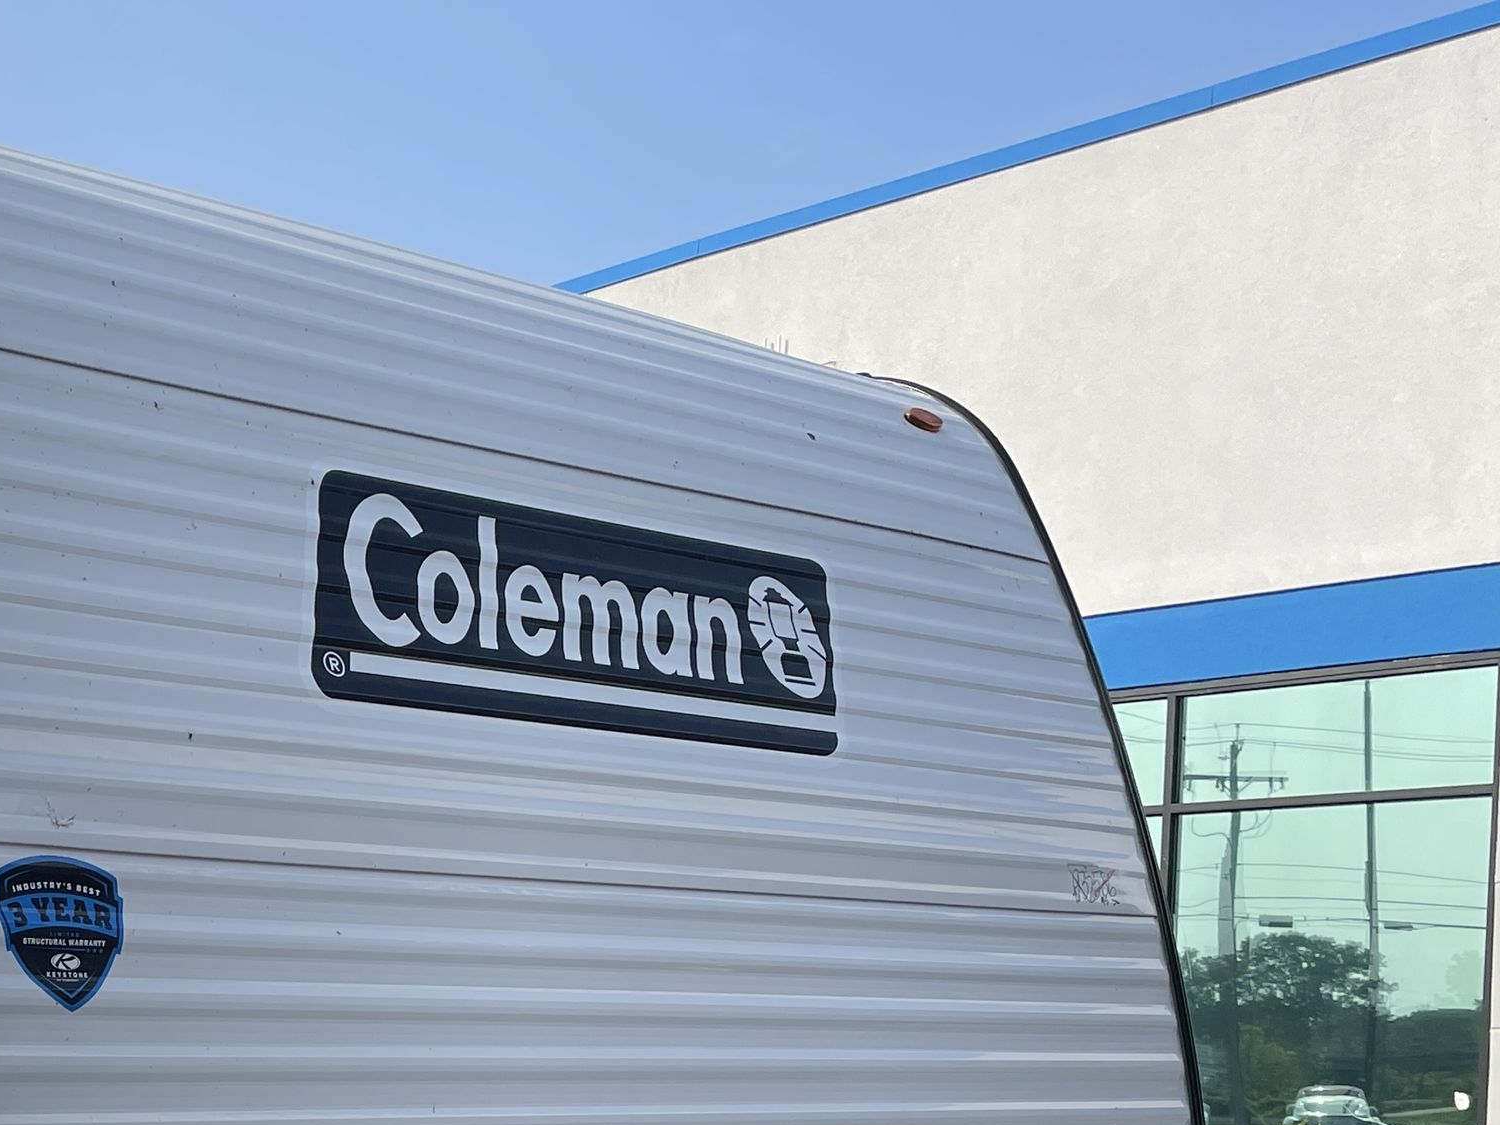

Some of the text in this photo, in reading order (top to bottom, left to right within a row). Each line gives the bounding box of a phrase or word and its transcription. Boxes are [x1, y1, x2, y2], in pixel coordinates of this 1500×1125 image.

[343, 492, 744, 685] Coleman
[11, 881, 101, 897] INDUSTRY'S BEST
[7, 896, 113, 931] 3 YEAR
[22, 937, 106, 947] STRUCTURAL WARRANTY
[46, 971, 89, 979] KEYSTONE
